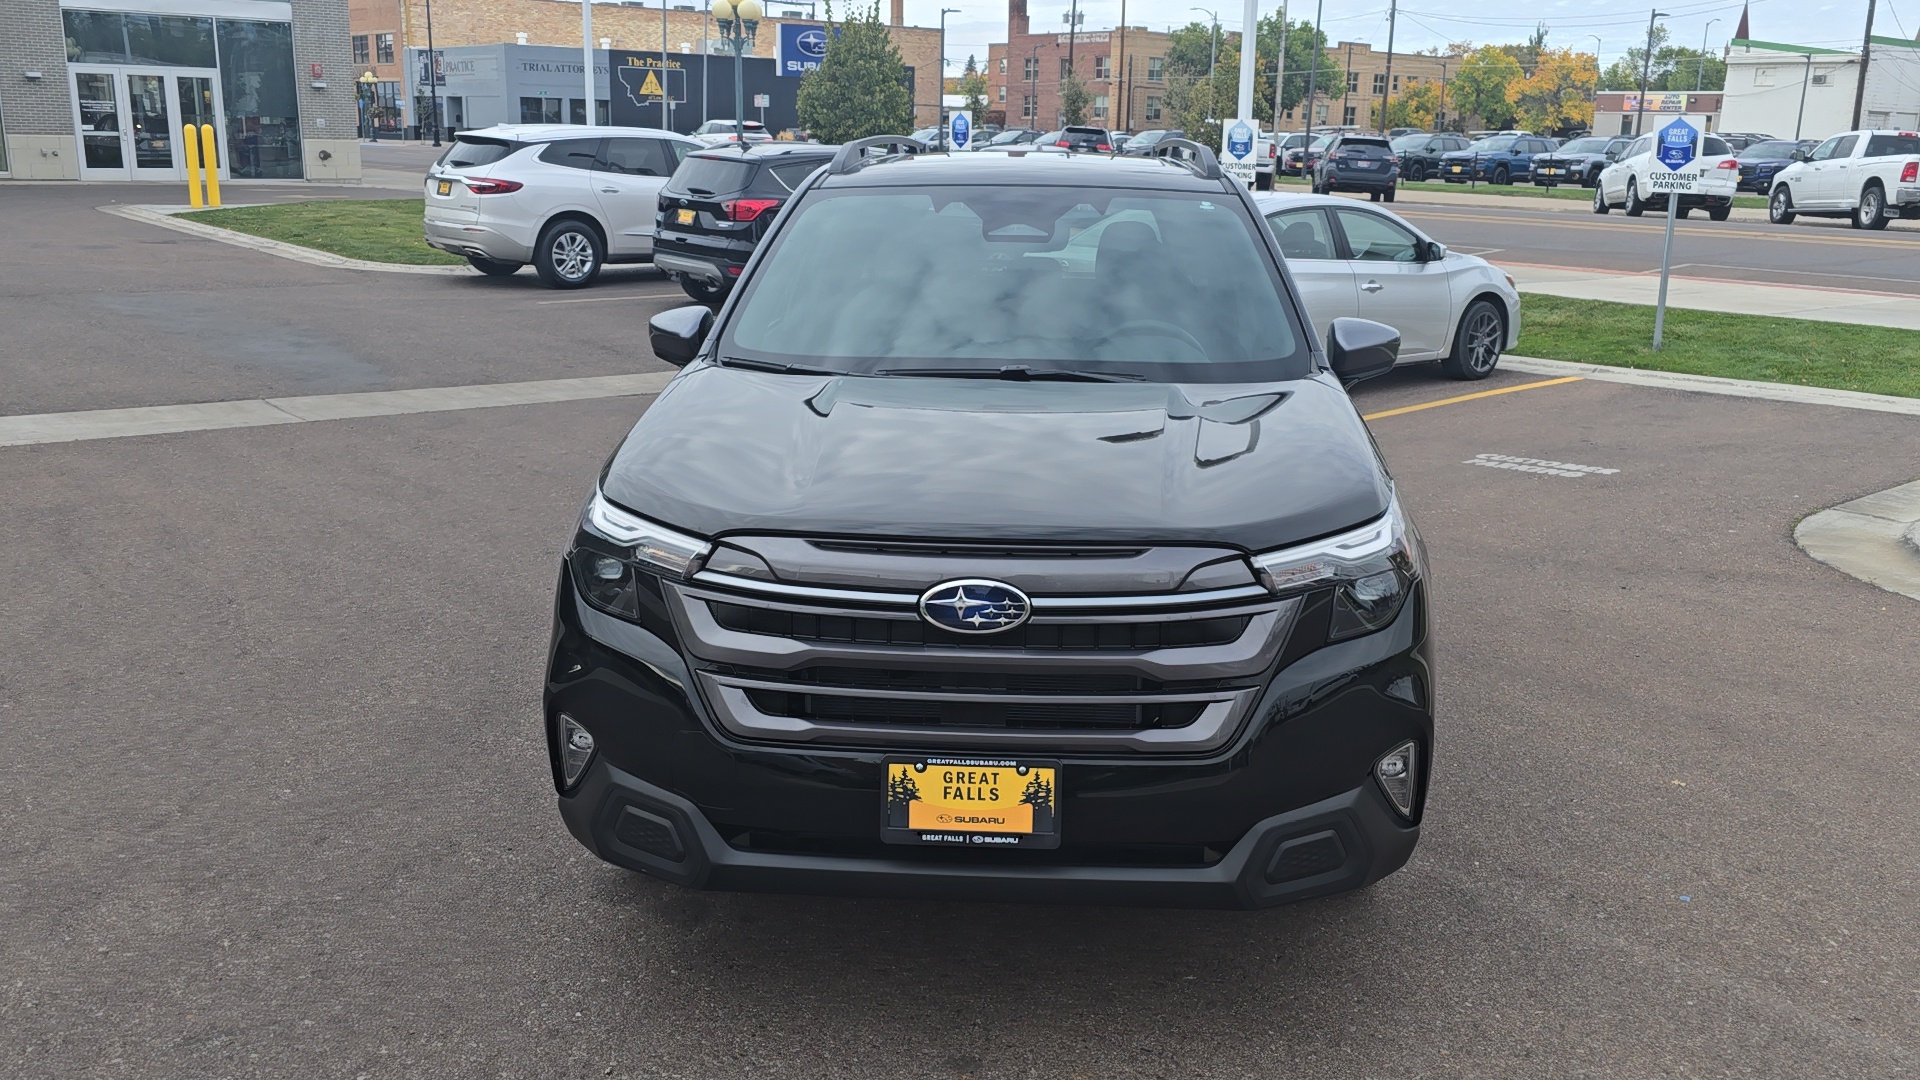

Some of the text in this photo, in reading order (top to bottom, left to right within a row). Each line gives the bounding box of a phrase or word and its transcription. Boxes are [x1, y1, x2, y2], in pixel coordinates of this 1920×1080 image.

[445, 60, 475, 72] PRACTICE
[626, 56, 681, 69] The Pratice
[787, 60, 821, 71] SUB
[521, 62, 609, 75] TRIAL ATTOREYS
[1668, 128, 1689, 136] GREAT
[1667, 135, 1688, 143] FALLS
[1649, 171, 1698, 181] CUSTOMER
[1652, 181, 1692, 190] PARKING
[926, 758, 1017, 767] GREATFALLSSUBARU.COM
[943, 771, 1000, 785] GREAT
[943, 786, 1000, 801] FALLS
[954, 815, 1006, 825] SUBARU
[921, 834, 1019, 844] GREAT FALLS SUBARU
